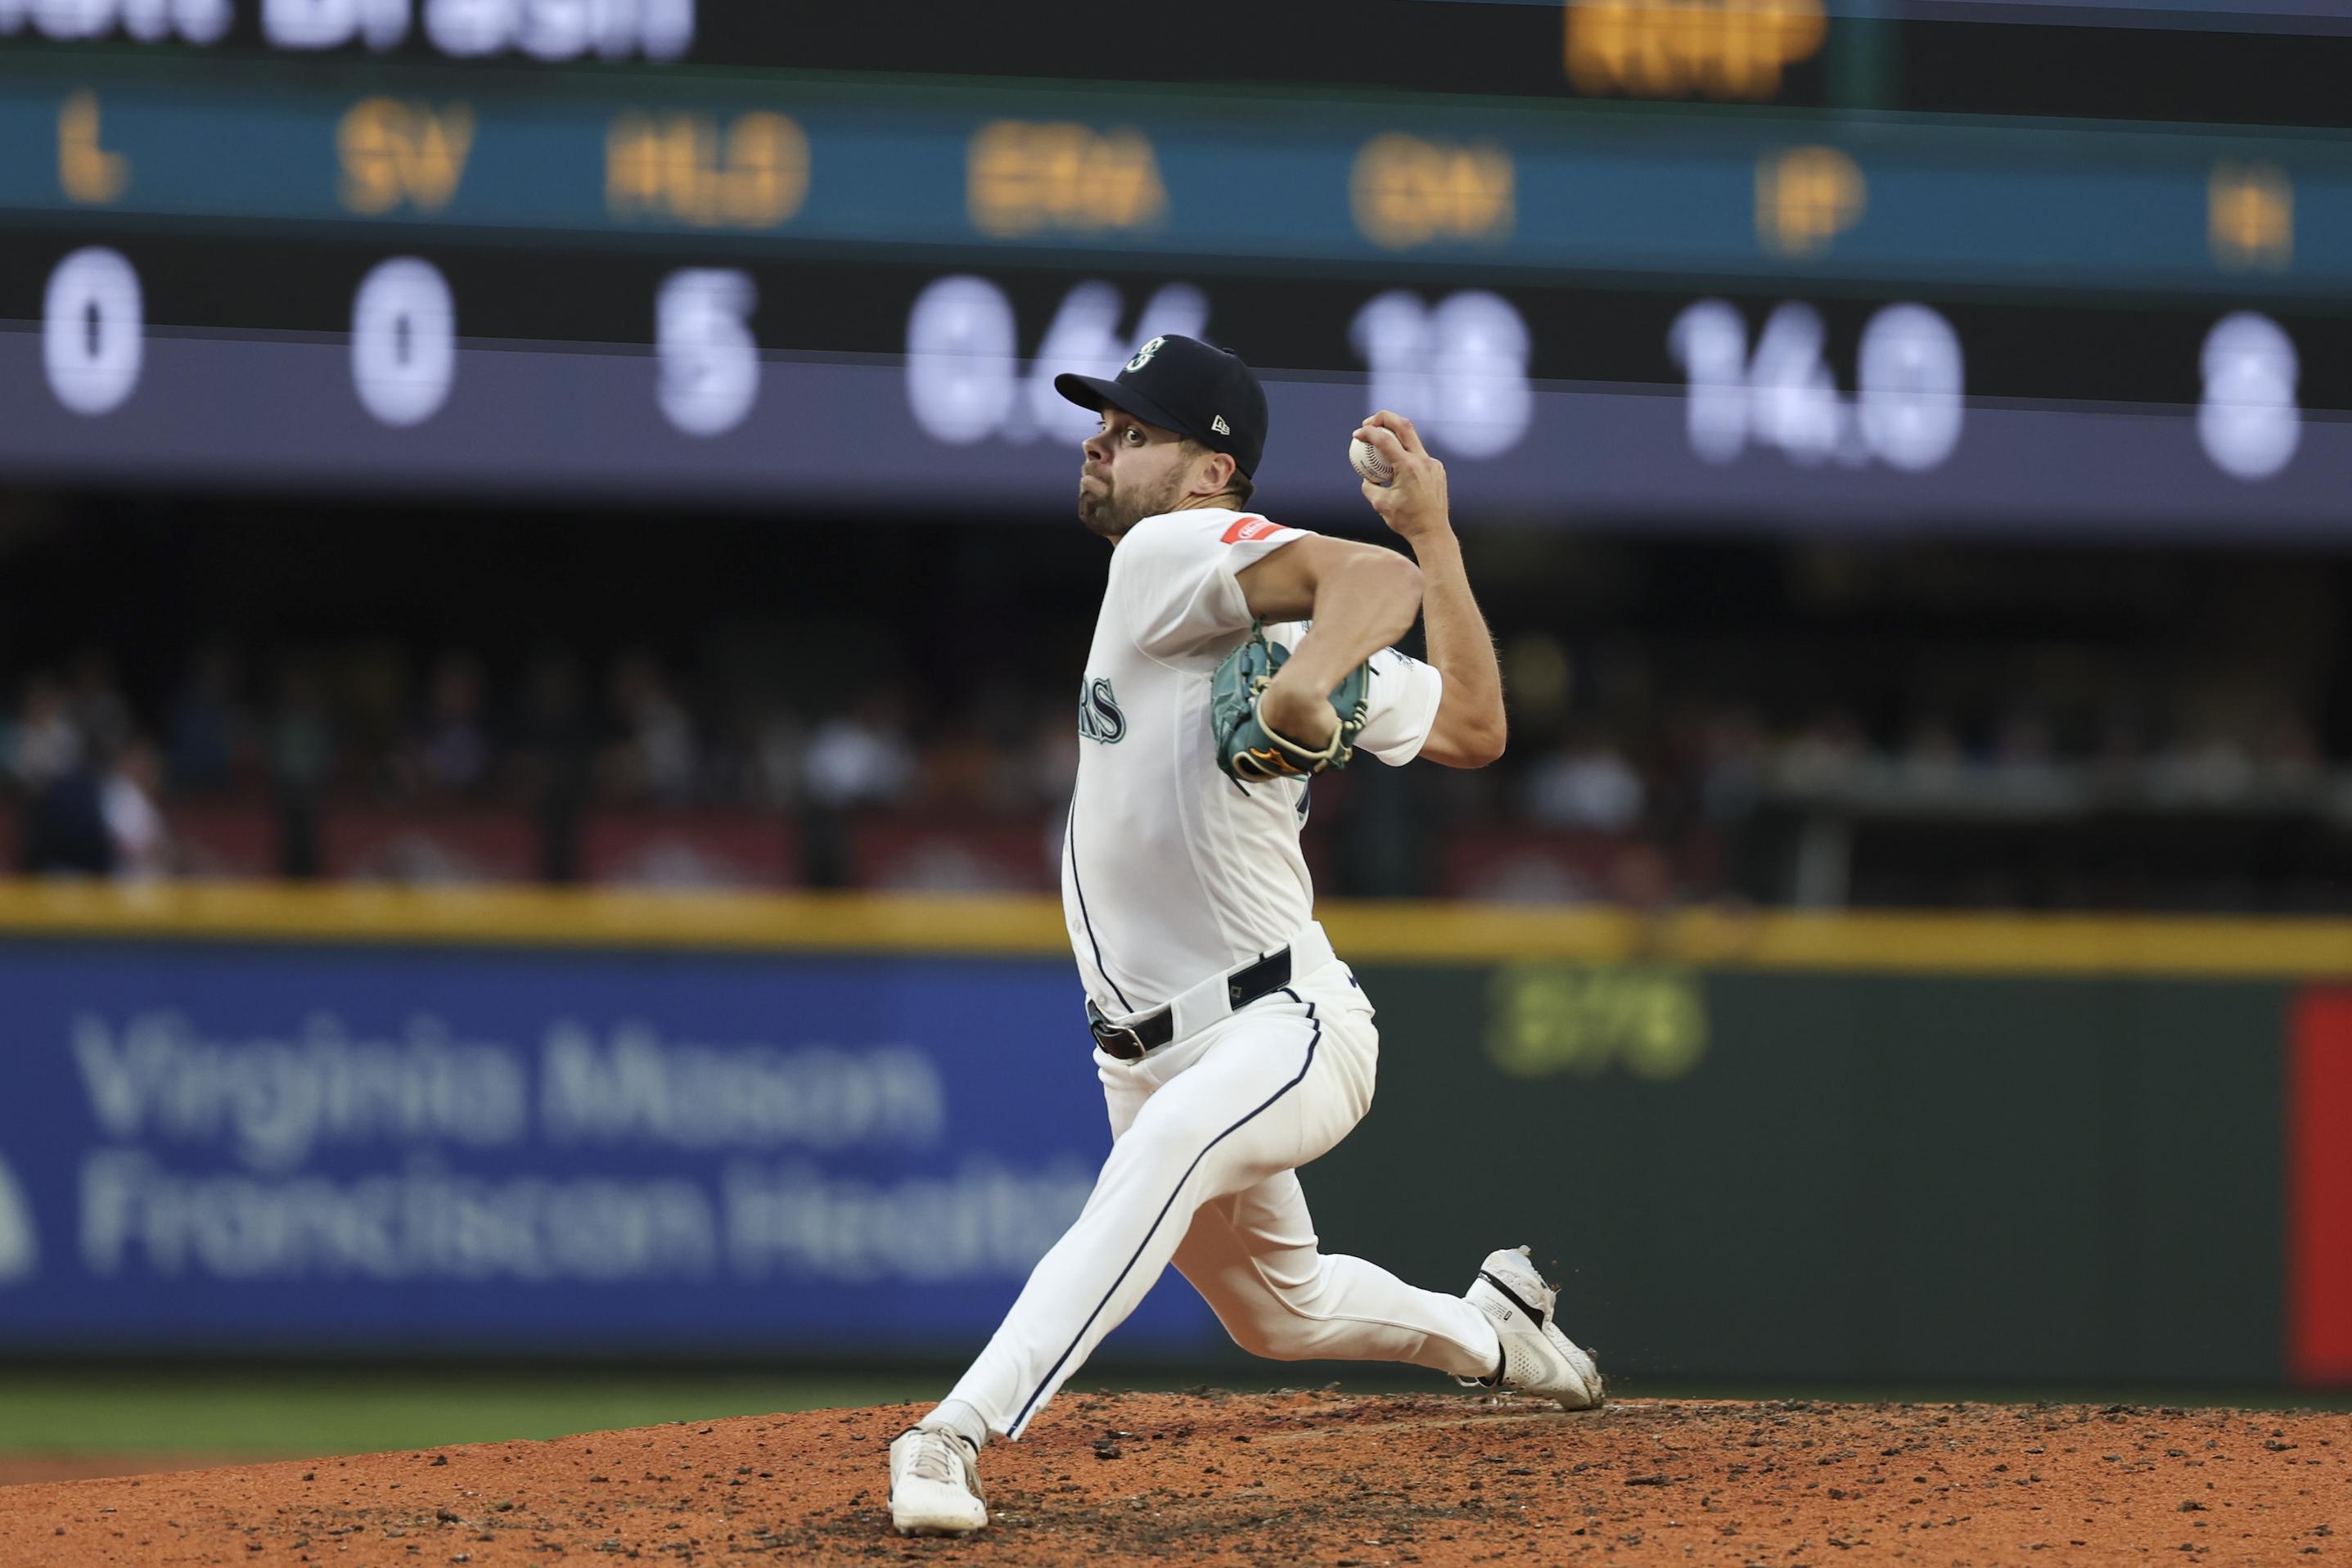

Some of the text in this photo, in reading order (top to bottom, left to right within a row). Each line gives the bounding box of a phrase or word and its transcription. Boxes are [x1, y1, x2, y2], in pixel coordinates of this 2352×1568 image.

[57, 85, 131, 205] L
[337, 97, 476, 218] SV
[43, 246, 144, 416] 0
[351, 255, 457, 427] 0
[656, 267, 761, 438] 5
[2199, 309, 2300, 480] 8
[70, 1008, 946, 1172] Virginia Mason
[78, 1146, 720, 1283] Franciscan
